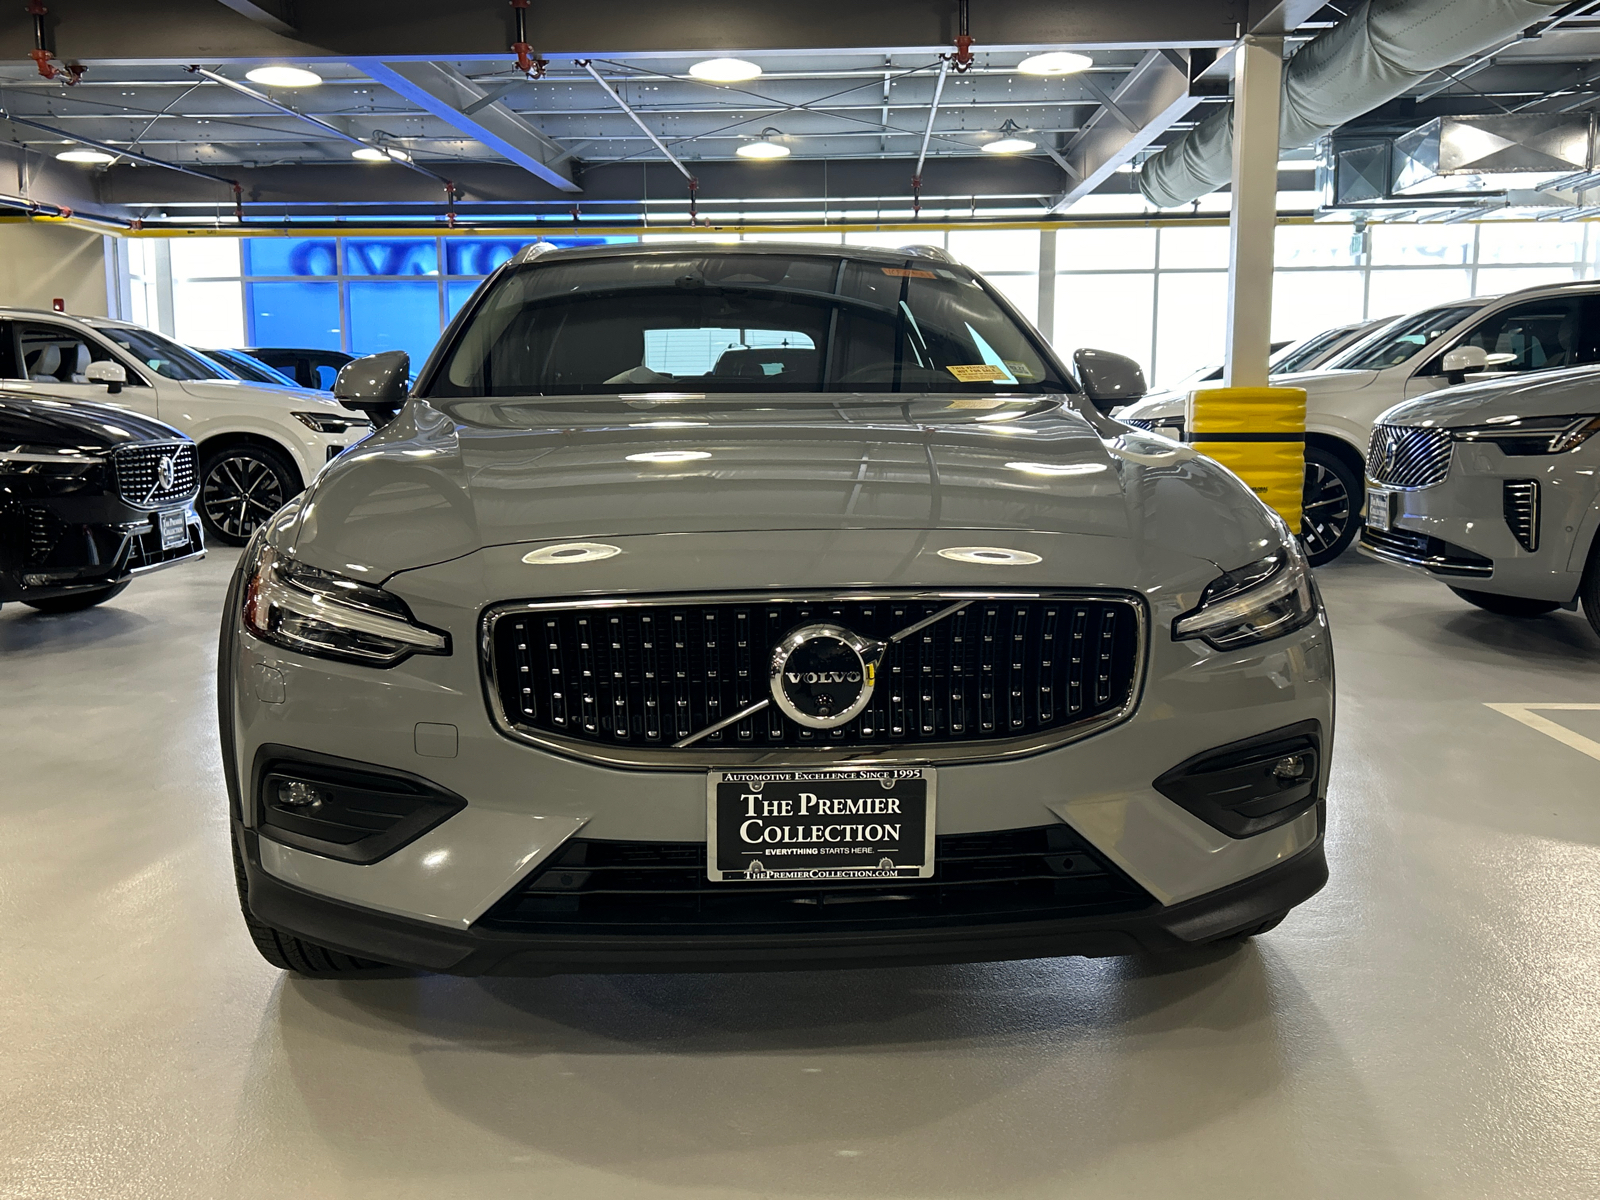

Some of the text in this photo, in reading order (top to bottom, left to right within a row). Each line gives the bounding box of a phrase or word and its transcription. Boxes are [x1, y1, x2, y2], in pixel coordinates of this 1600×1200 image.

[786, 671, 861, 684] VOLVO
[725, 769, 921, 781] AUTOMOTIVE EXCELLENCE SINCE 1995
[740, 793, 902, 817] THE PREMIER
[739, 819, 902, 844] COLLECTION
[851, 846, 875, 854] HERE.
